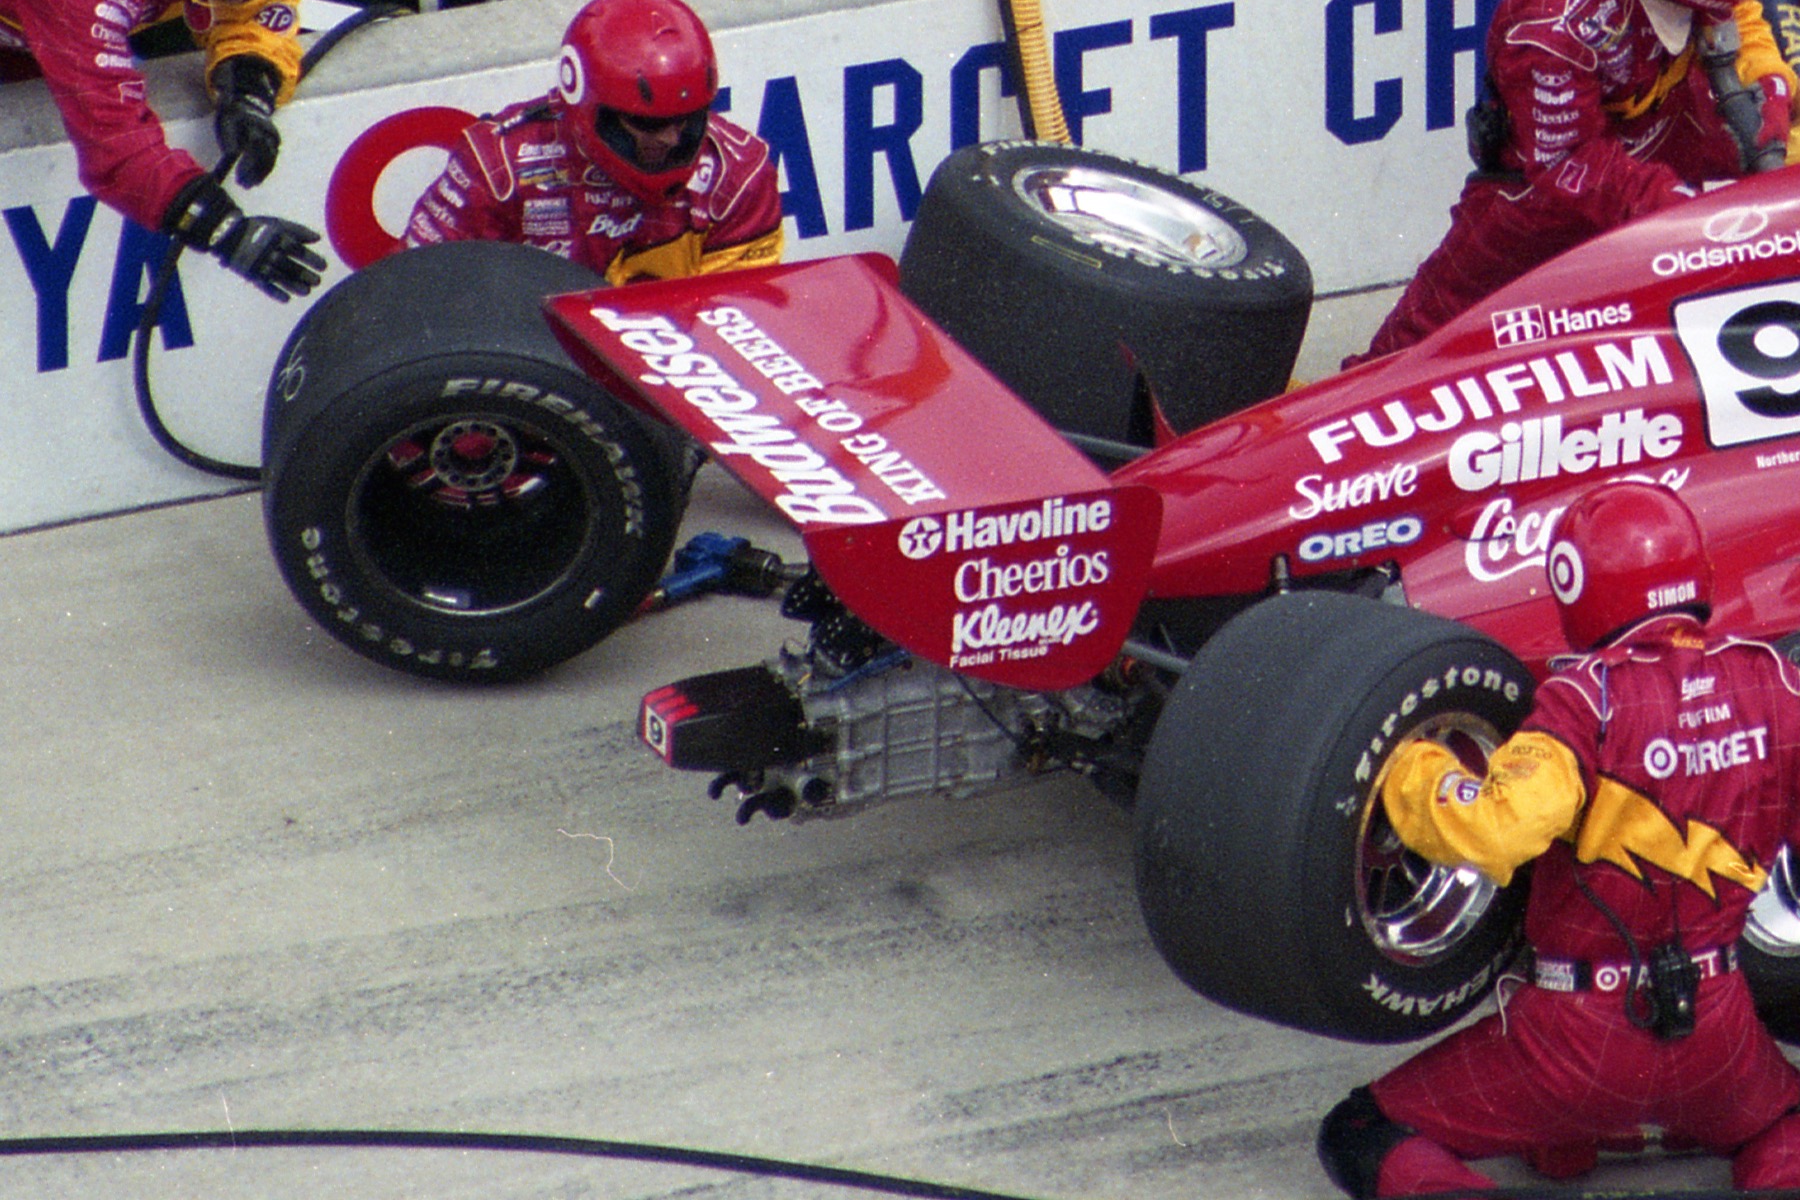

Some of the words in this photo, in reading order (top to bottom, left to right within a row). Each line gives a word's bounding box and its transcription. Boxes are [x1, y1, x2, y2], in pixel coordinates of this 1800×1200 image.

[257, 3, 293, 31] STP
[713, 2, 1236, 239] ARGET
[1532, 106, 1580, 124] Cheerios
[1548, 302, 1633, 338] Hanes
[696, 305, 827, 397] BEERS
[589, 306, 889, 525] Budweiser
[795, 390, 863, 435] OF
[1306, 335, 1674, 465] FUJIFILM
[440, 376, 645, 539] FIREHAWK
[841, 434, 948, 506] KING
[1447, 407, 1684, 492] Gillette
[1288, 462, 1418, 521] Suave
[945, 498, 1112, 552] Havoline
[1298, 516, 1423, 562] OREO
[954, 545, 1110, 603] Cheerios
[1647, 580, 1696, 610] SIMON
[951, 601, 1099, 654] Kleenex
[950, 651, 995, 668] Facial
[999, 645, 1048, 662] Tissue
[1352, 665, 1520, 784] Firestone
[1677, 726, 1768, 777] TARGET
